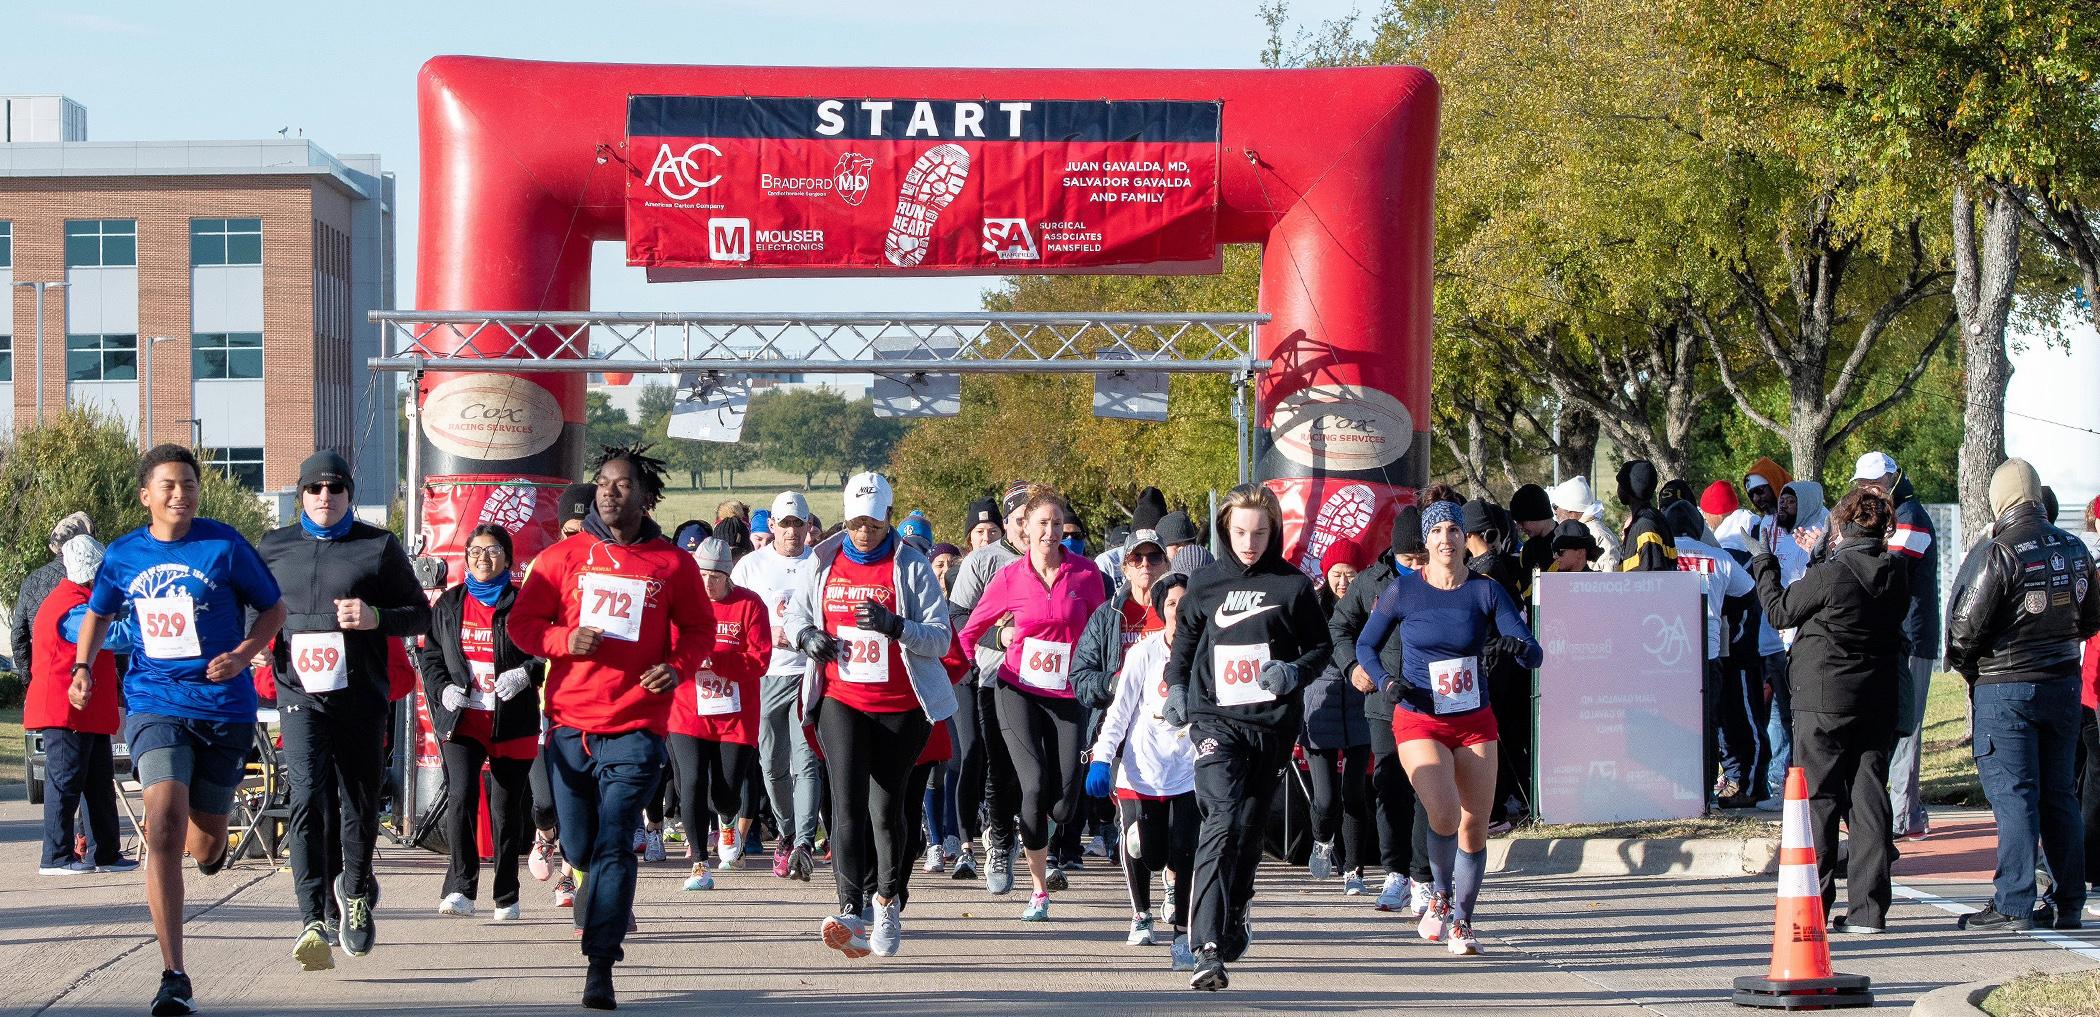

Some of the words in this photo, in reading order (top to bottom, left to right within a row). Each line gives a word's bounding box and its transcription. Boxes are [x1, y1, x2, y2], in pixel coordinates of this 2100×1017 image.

[815, 99, 1032, 138] START
[1064, 161, 1099, 172] JUAN
[1102, 161, 1165, 173] GAVALDA,
[1167, 162, 1190, 173] MD,
[761, 173, 834, 190] BRADFORD
[839, 176, 868, 191] MD
[1062, 177, 1130, 188] SALVADOR
[1133, 177, 1192, 188] GAVALDA
[696, 202, 725, 210] Company
[1089, 192, 1118, 202] AND
[1121, 192, 1165, 203] FAMILY
[895, 201, 926, 221] RUN
[892, 214, 934, 237] HEART
[1039, 221, 1086, 230] SURGICAL
[755, 229, 824, 243] MOUSER
[1044, 232, 1102, 241] ASSOCIATES
[755, 243, 824, 252] ELECTRONICS
[1047, 243, 1102, 253] MANSFIELD
[460, 403, 524, 423] Cox
[448, 423, 484, 432] RACING
[486, 423, 533, 434] SERVICES
[1300, 433, 1337, 443] RACING
[1339, 433, 1386, 444] SERVICES
[1310, 530, 1337, 547] RUN
[591, 588, 632, 619] 712
[1222, 590, 1267, 612] NIKE
[146, 612, 187, 638] 529
[297, 647, 340, 673] 659
[842, 640, 880, 664] 528
[1029, 651, 1062, 673] 661
[1223, 658, 1262, 685] 681
[701, 679, 734, 700] 526
[1438, 669, 1474, 696] 568
